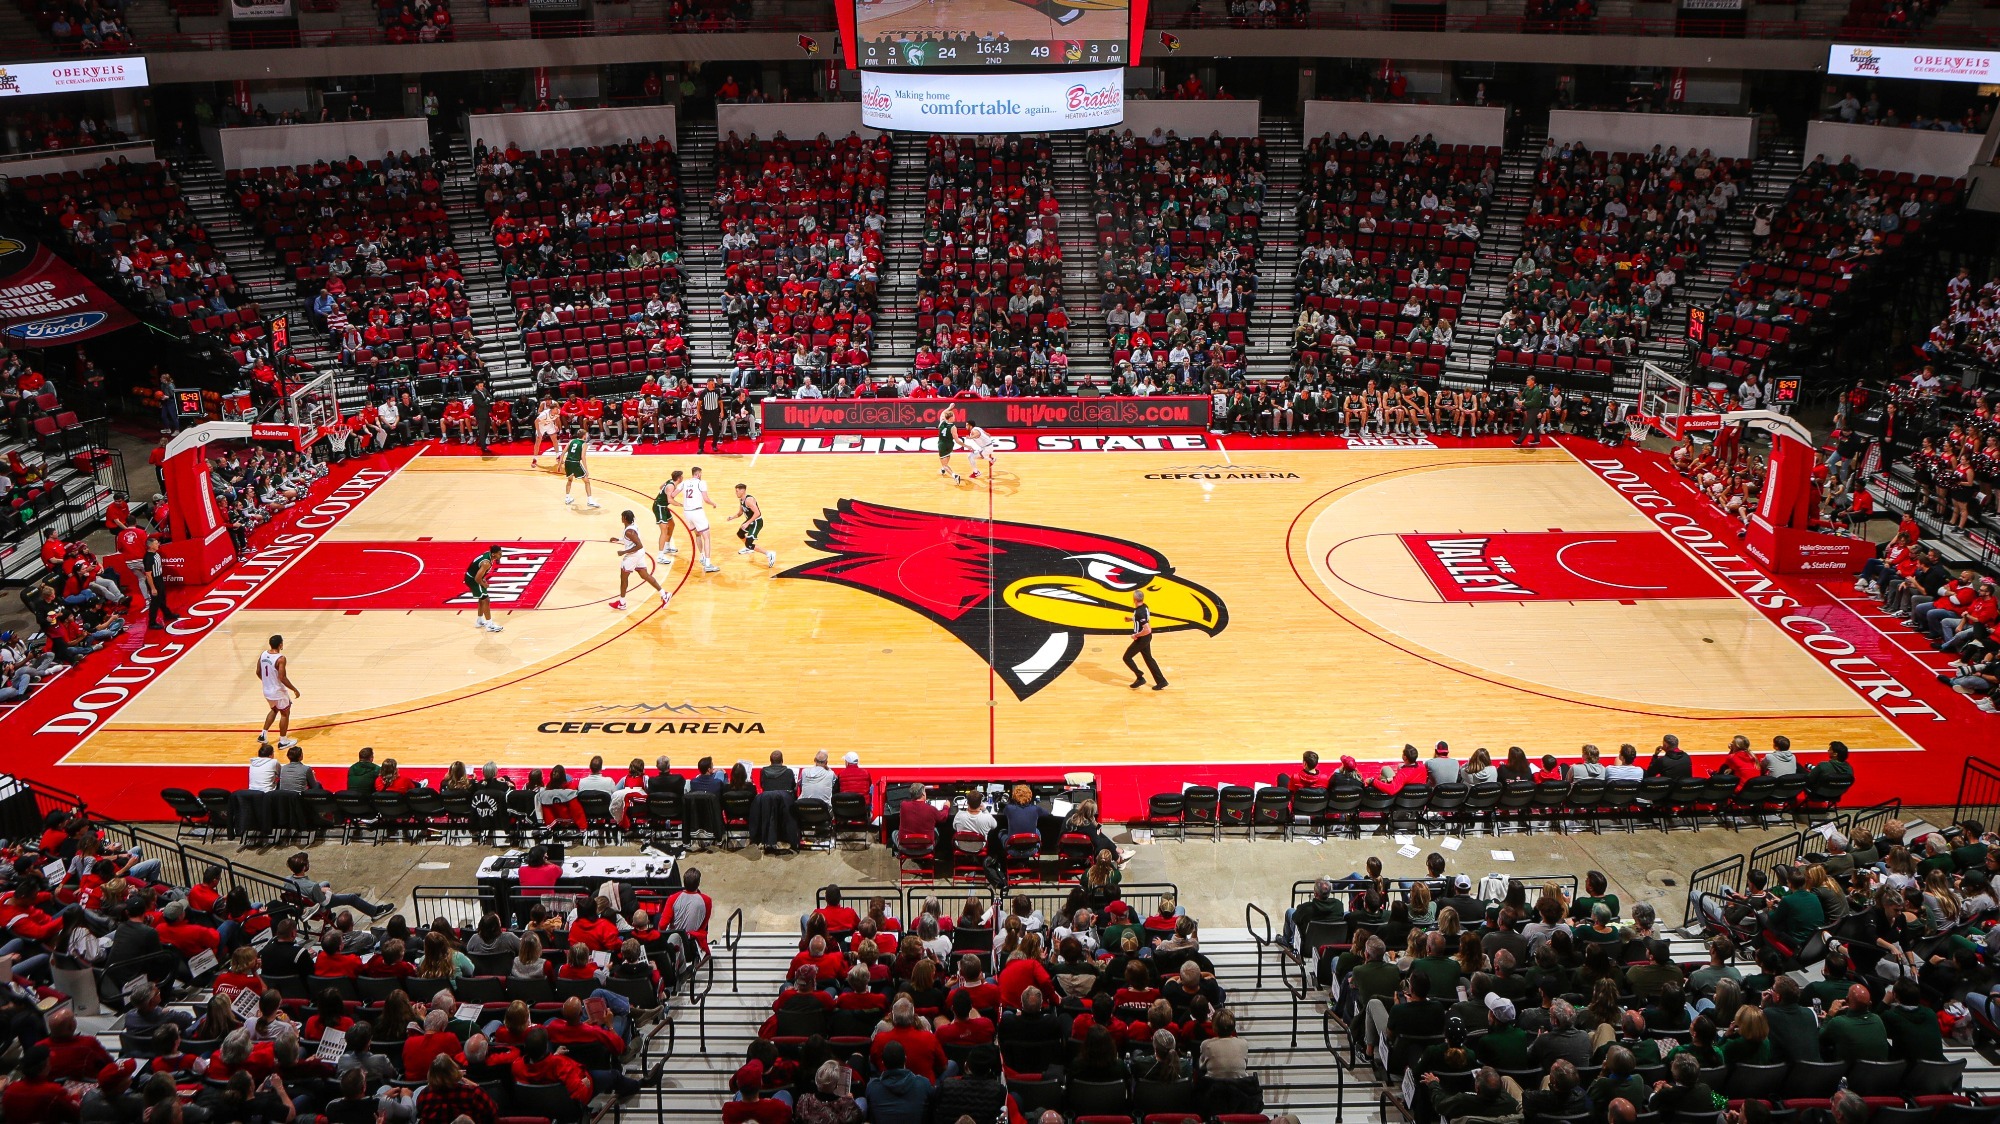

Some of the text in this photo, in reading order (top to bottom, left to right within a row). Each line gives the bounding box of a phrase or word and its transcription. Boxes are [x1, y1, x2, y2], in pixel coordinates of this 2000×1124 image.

[868, 47, 876, 56] 0
[889, 47, 896, 56] 3
[938, 48, 957, 59] 24
[976, 43, 1010, 54] 16:43
[1031, 47, 1050, 58] 49
[1091, 44, 1098, 54] 3
[1110, 44, 1118, 53] 0
[1913, 55, 1990, 68] OBERWEIS
[52, 65, 125, 78] OBERWEIS
[894, 89, 950, 101] Making home
[1067, 84, 1120, 111] Bratcher
[921, 99, 1057, 115] comfortable again...
[0, 292, 57, 308] STATE
[27, 317, 88, 337] Ford
[1689, 318, 1703, 340] 24
[273, 329, 287, 353] 24
[1779, 380, 1798, 389] 16:43
[180, 392, 200, 402] 16:43
[1778, 389, 1794, 400] 24
[183, 401, 198, 412] 24
[941, 427, 948, 437] 4
[546, 444, 633, 452] AENA
[571, 443, 578, 453] 2
[1036, 435, 1208, 450] STATE
[685, 488, 694, 499] 12
[1426, 538, 1537, 595] THE VALLEY
[445, 546, 555, 604] VALLEY
[1585, 458, 1947, 722] DOUG COLLINS COURT
[32, 467, 392, 737] DOUG COLLINS COURT
[264, 665, 269, 677] 1
[537, 721, 766, 734] CEFCU ARENA
